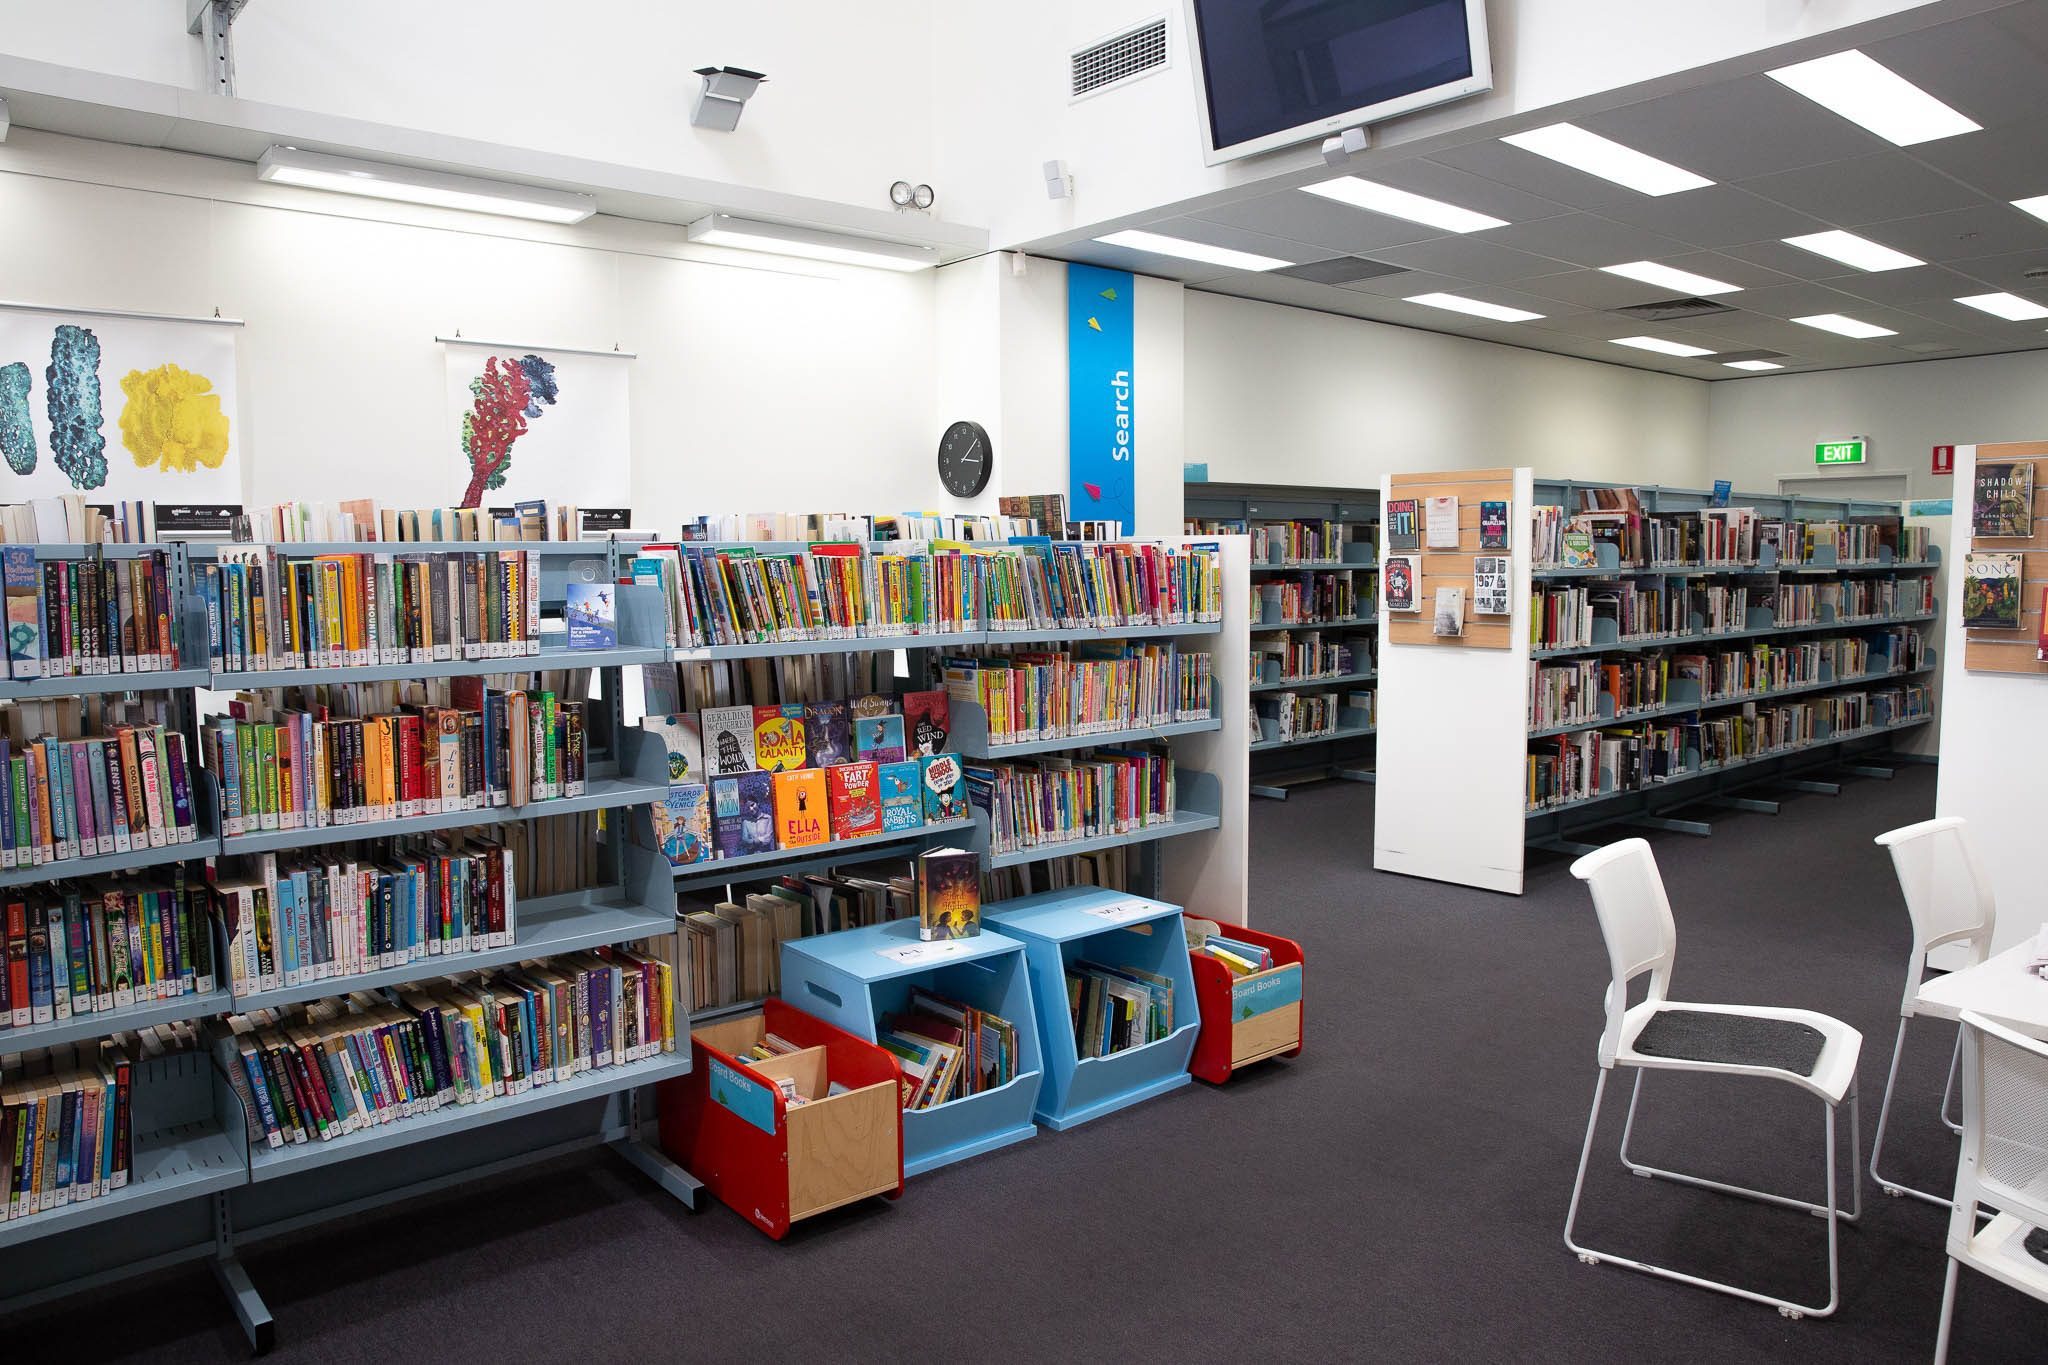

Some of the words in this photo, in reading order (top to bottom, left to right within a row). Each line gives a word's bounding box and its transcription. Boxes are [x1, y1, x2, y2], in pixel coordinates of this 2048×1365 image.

[1111, 371, 1129, 461] Search
[1823, 445, 1853, 461] EXIT
[1980, 477, 2023, 487] SHADOW
[1986, 489, 2017, 498] CHILD
[1388, 501, 1414, 513] DOING
[1398, 513, 1415, 535] IT!
[1967, 561, 2017, 575] SONG
[367, 576, 375, 601] LILY'S
[1476, 575, 1495, 588] 1967
[706, 710, 751, 722] GERALDINE
[759, 721, 805, 748] KOALA
[917, 725, 932, 734] RED
[917, 731, 944, 743] WIND
[720, 743, 737, 753] THE
[760, 745, 804, 759] CALAMITY
[720, 753, 744, 765] WORLD
[928, 758, 951, 773] MIDDLE
[109, 760, 121, 790] KENSY
[129, 765, 137, 784] COOL
[843, 769, 869, 782] FART
[929, 767, 954, 781] SCHOOL
[844, 780, 869, 789] POWDER
[132, 785, 141, 811] BEANS
[227, 787, 239, 813] 1986
[670, 800, 696, 809] VENICE
[114, 796, 125, 816] MAX
[886, 807, 913, 818] ROYAL
[788, 818, 820, 835] ELLA
[884, 814, 917, 827] RABBITS
[796, 832, 821, 843] OUTSIDE
[1232, 985, 1255, 1000] Board
[1257, 976, 1281, 991] Books
[729, 1071, 752, 1092] Books
